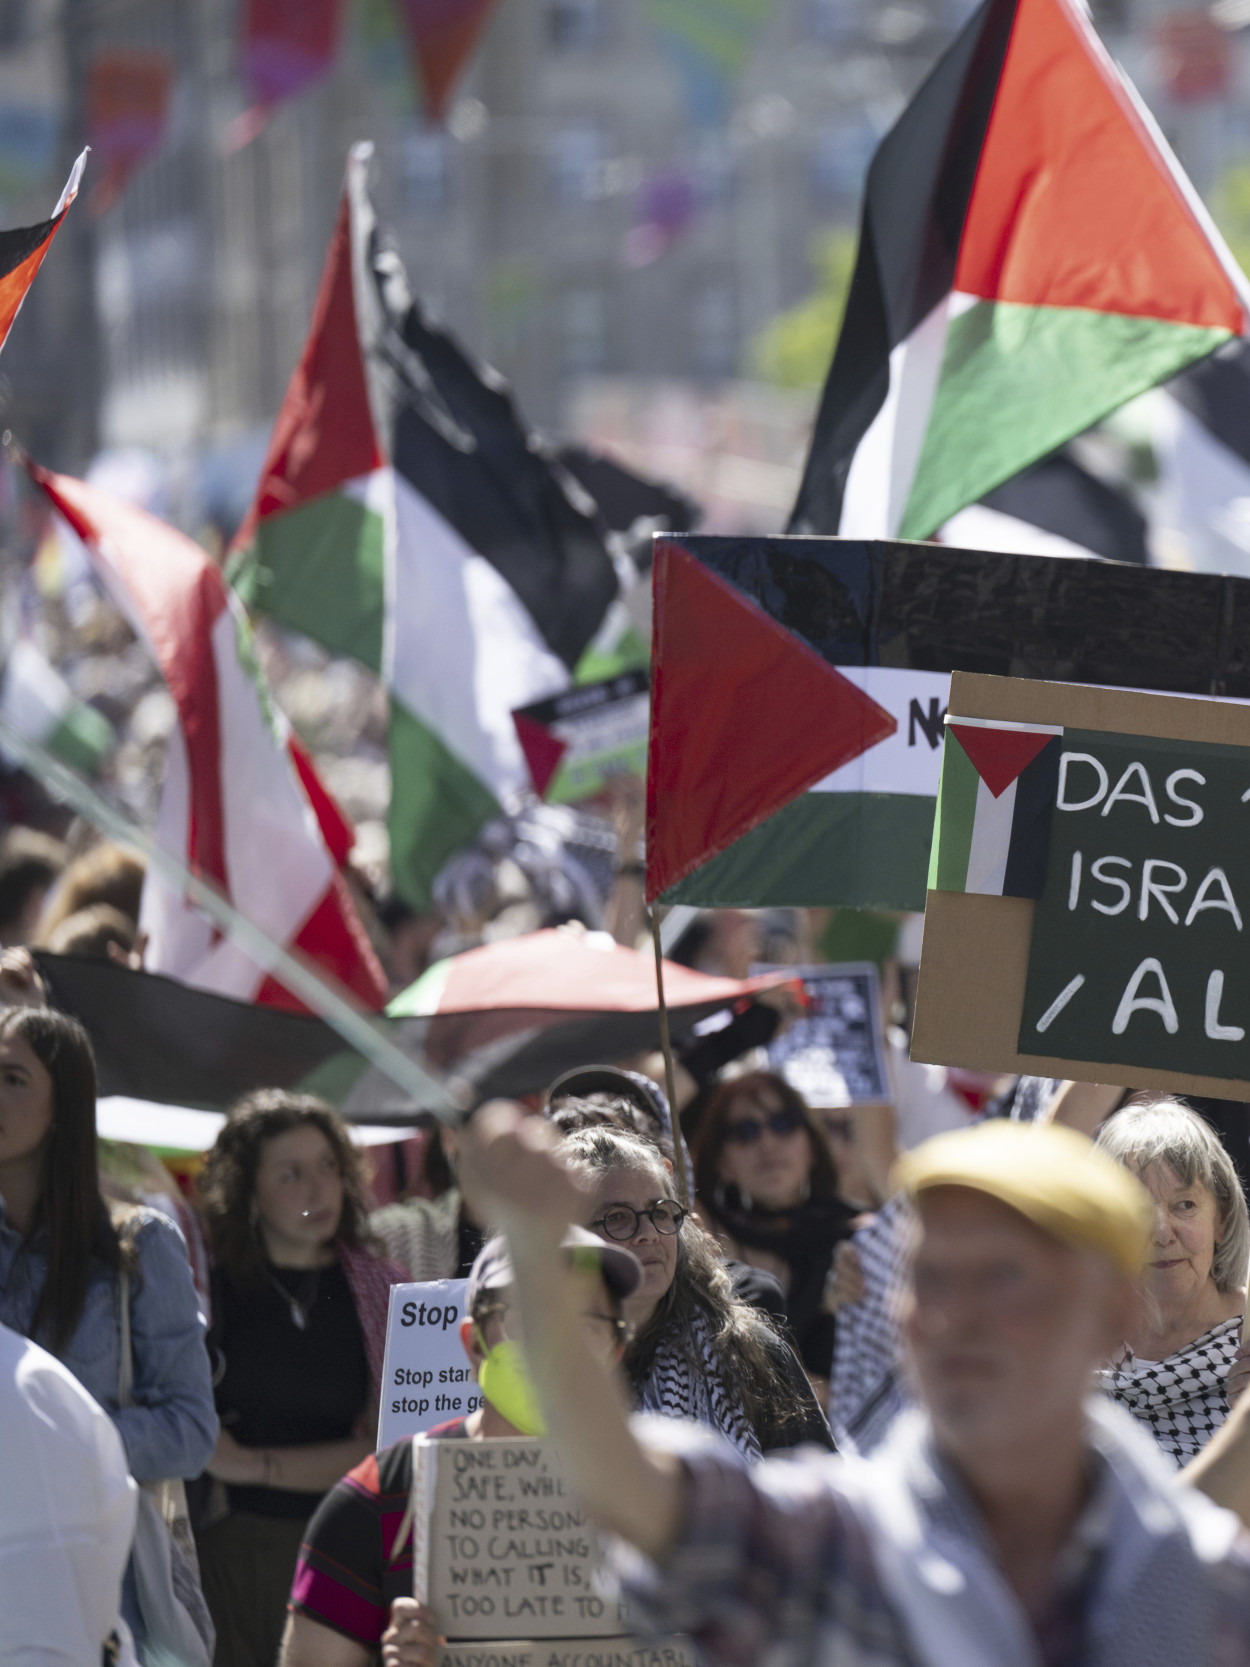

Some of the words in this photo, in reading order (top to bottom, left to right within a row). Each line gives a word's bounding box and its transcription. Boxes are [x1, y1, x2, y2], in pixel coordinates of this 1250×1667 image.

[908, 697, 947, 750] N
[1056, 751, 1206, 827] DAS
[400, 1301, 458, 1331] Stop
[394, 1368, 433, 1388] Stop
[438, 1366, 471, 1383] star
[391, 1397, 429, 1416] stop
[435, 1394, 462, 1411] the
[467, 1395, 485, 1414] ge
[503, 1448, 548, 1473] DAY,
[452, 1474, 516, 1503] SAFE,
[449, 1508, 486, 1531] NO
[492, 1509, 586, 1531] PERSON
[446, 1535, 480, 1561] TO
[487, 1535, 591, 1560] CALLING
[449, 1567, 516, 1587] WHAT
[528, 1563, 555, 1587] IT
[563, 1564, 591, 1592] IS,
[446, 1593, 496, 1619] TOO
[503, 1594, 565, 1618] LATE
[574, 1595, 605, 1619] TO
[439, 1652, 533, 1667] ANYONE
